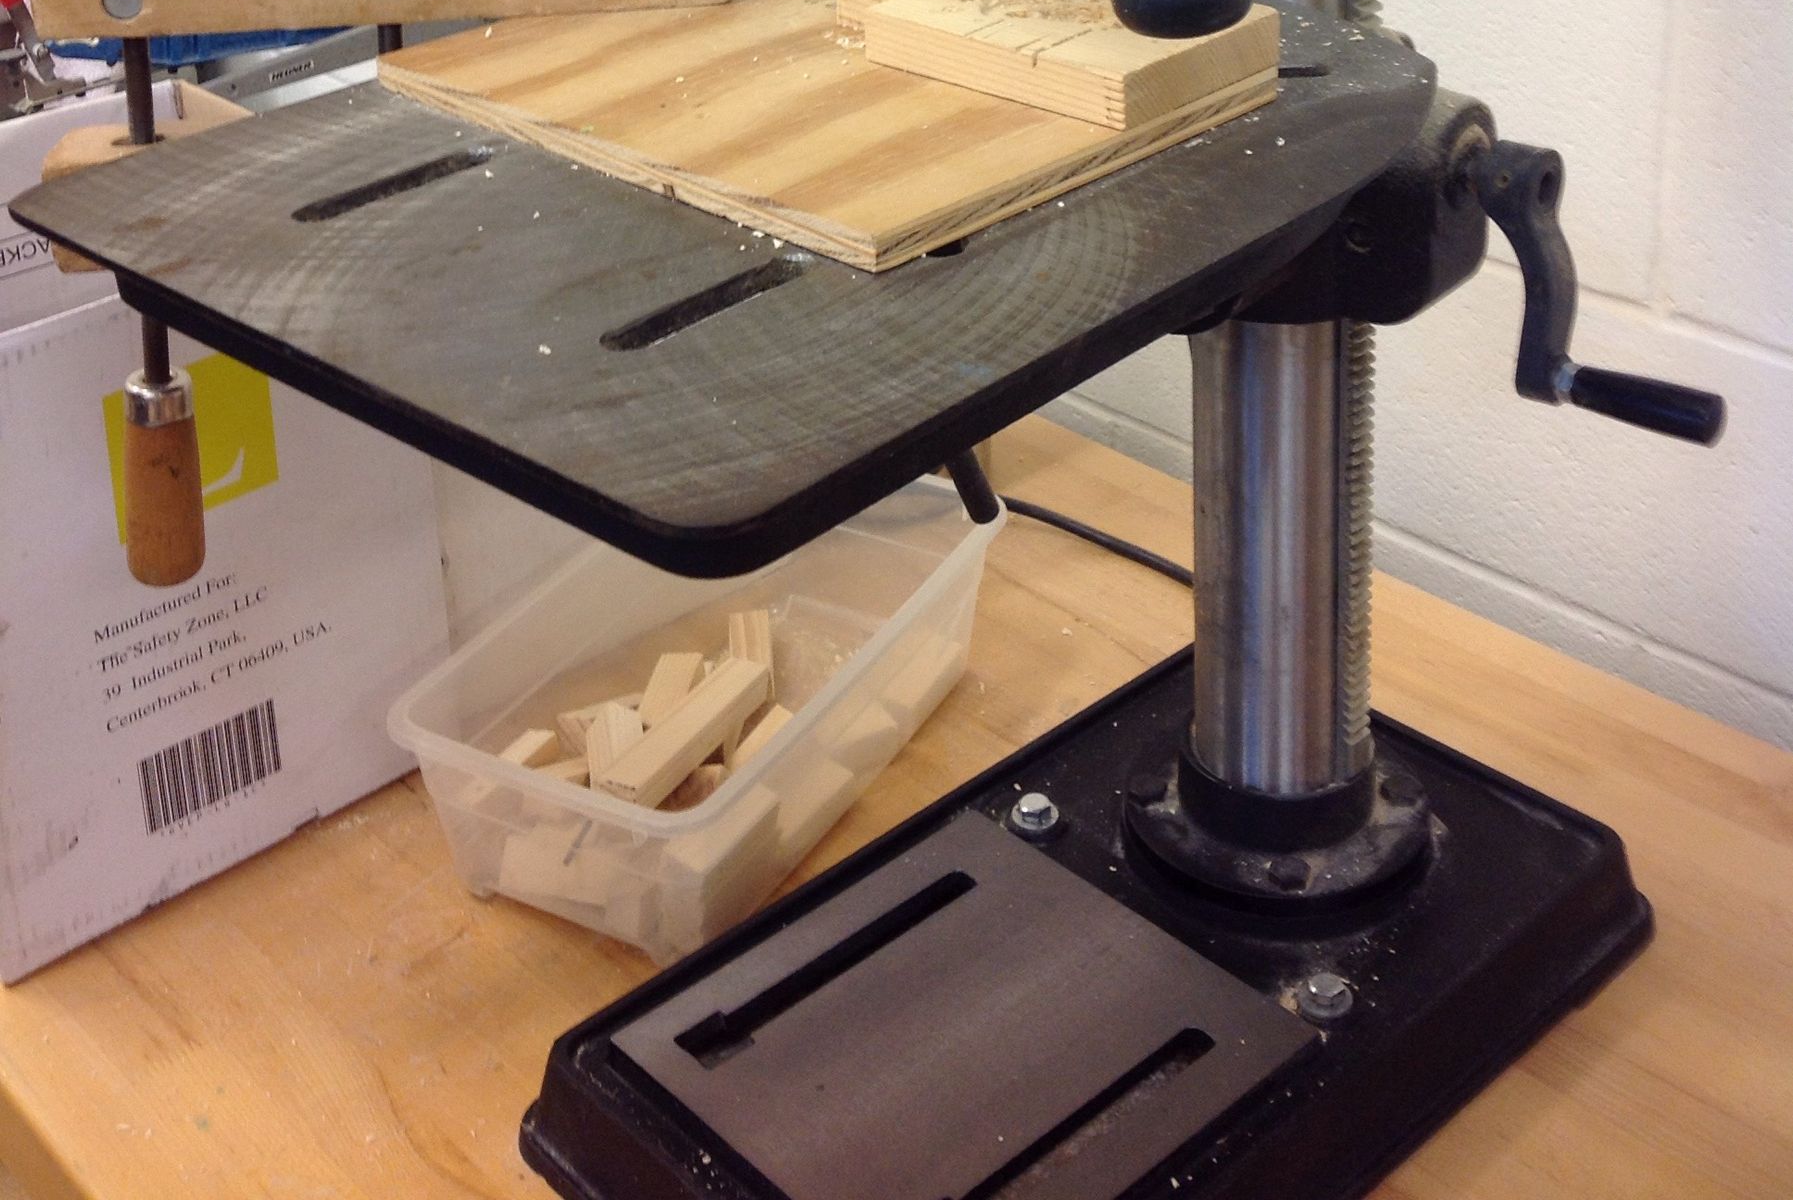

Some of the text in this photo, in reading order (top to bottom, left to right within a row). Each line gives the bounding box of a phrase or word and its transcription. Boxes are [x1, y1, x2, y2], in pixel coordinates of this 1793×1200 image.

[94, 572, 237, 643] Manufactured For:
[98, 584, 268, 673] The Safety Zone, LLC
[105, 684, 122, 701] 39
[132, 646, 203, 691] Industrial
[106, 620, 332, 734] Centerbrook, CT 06409, USA.
